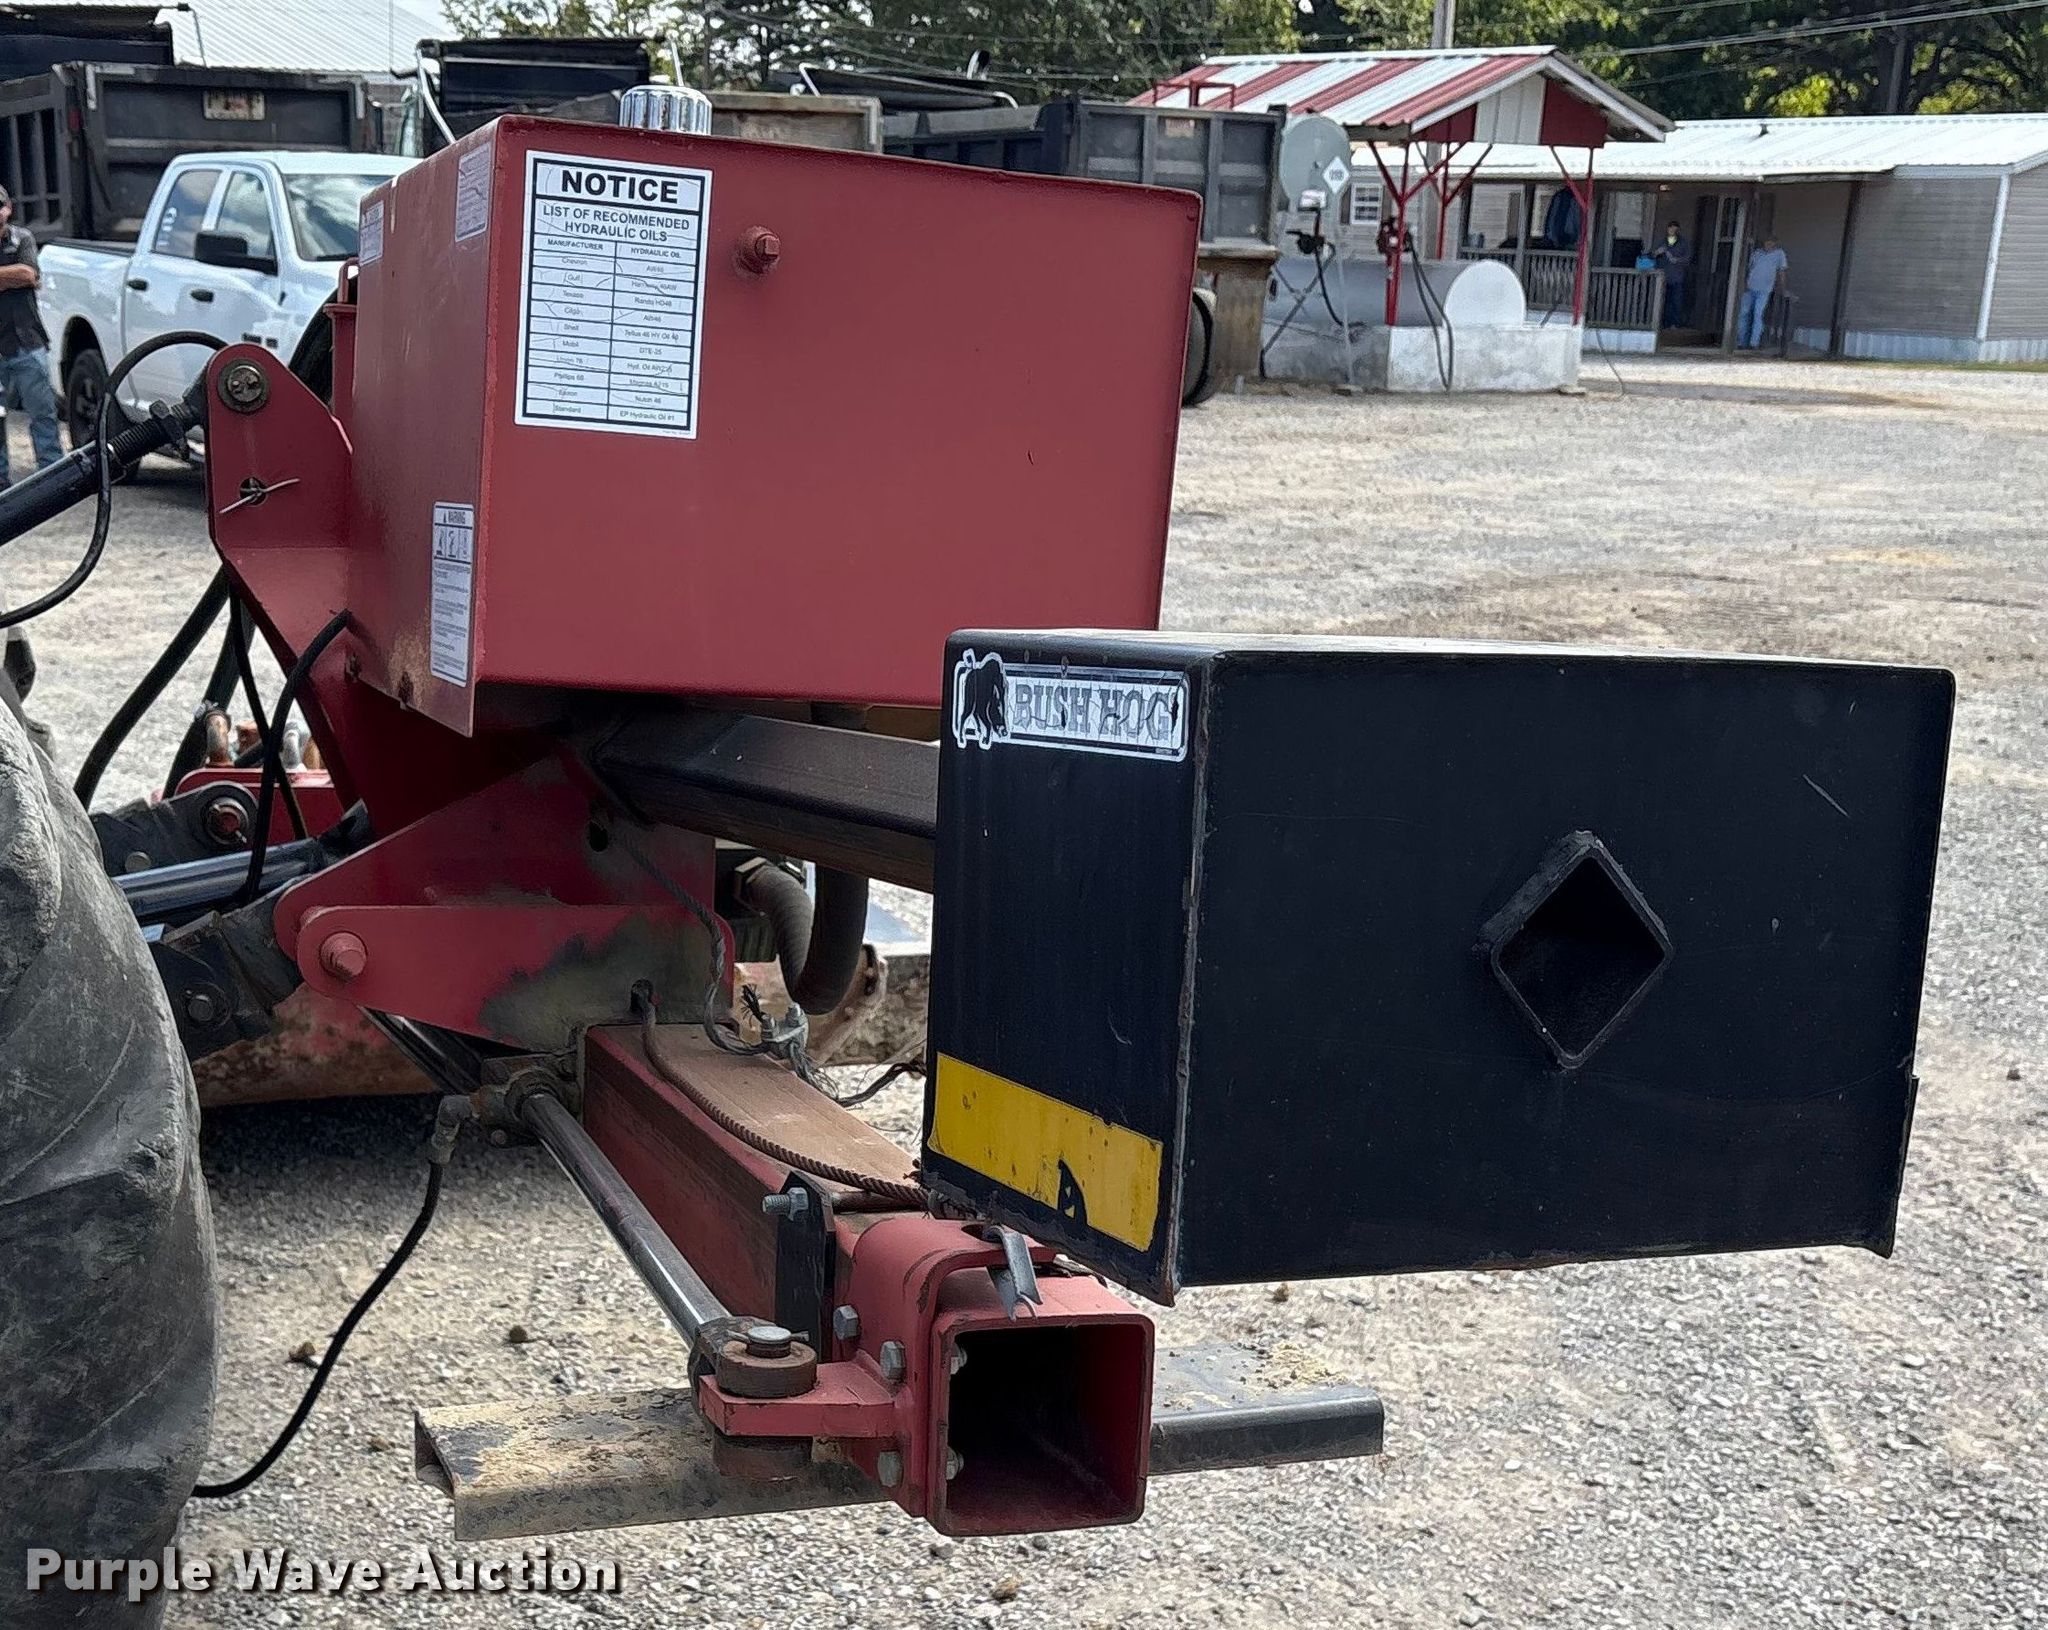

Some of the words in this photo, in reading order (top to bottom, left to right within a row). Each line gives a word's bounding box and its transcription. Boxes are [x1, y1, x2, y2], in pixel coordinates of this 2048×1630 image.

[562, 169, 679, 204] NOTICE
[543, 204, 570, 217] LIST
[573, 207, 590, 219] OF
[593, 209, 689, 230] RECOMMENDED
[565, 220, 636, 239] HYDRAULIC
[639, 228, 667, 242] OILS
[547, 238, 603, 250] MANUFACTURER
[631, 247, 669, 258] HYDRAULIC
[562, 257, 588, 265] Chevron
[567, 273, 581, 281] Gulf
[563, 289, 584, 298] Texaco
[1013, 683, 1092, 736] BUSH
[1099, 687, 1173, 740] HOG
